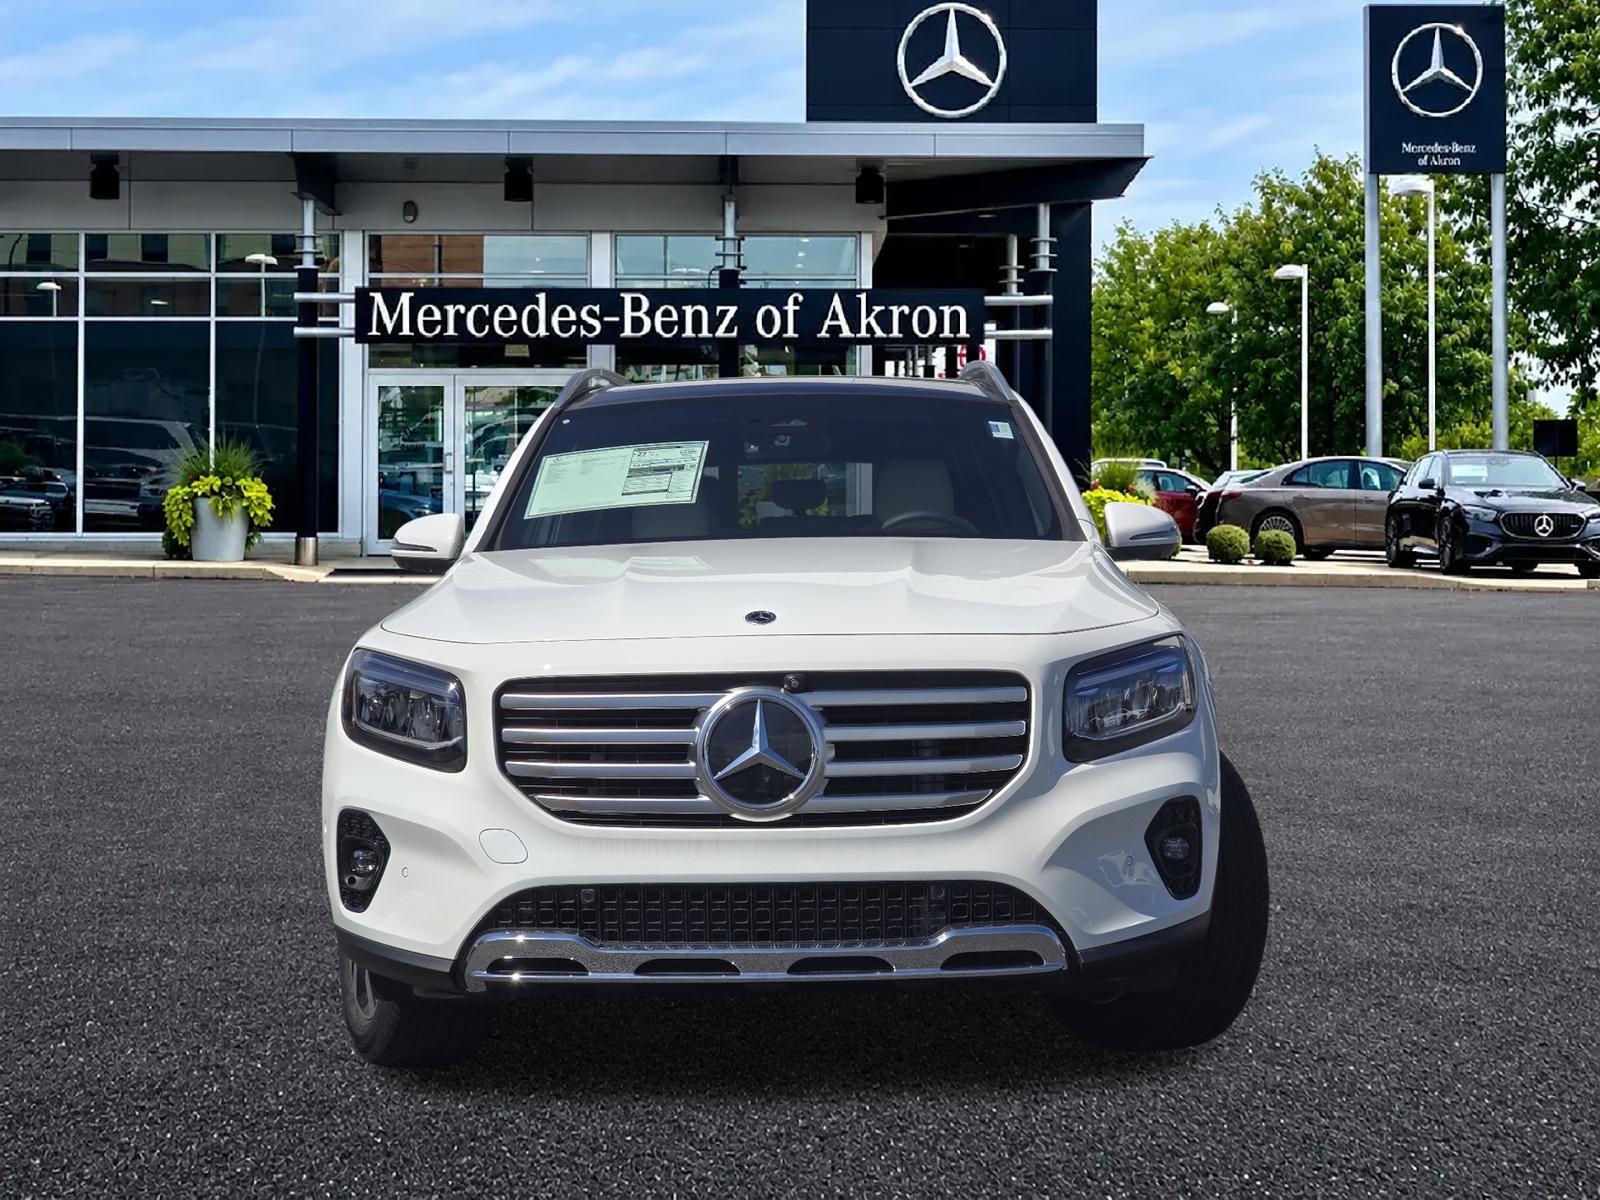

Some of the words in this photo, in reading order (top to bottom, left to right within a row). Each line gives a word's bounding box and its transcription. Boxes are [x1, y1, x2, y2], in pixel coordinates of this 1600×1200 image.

[1401, 141, 1477, 154] Mercedes-Benz
[1417, 154, 1429, 166] of
[1430, 154, 1461, 166] Akron
[367, 291, 738, 338] Mercedes-Benz
[755, 291, 801, 338] of
[817, 291, 971, 338] Akron
